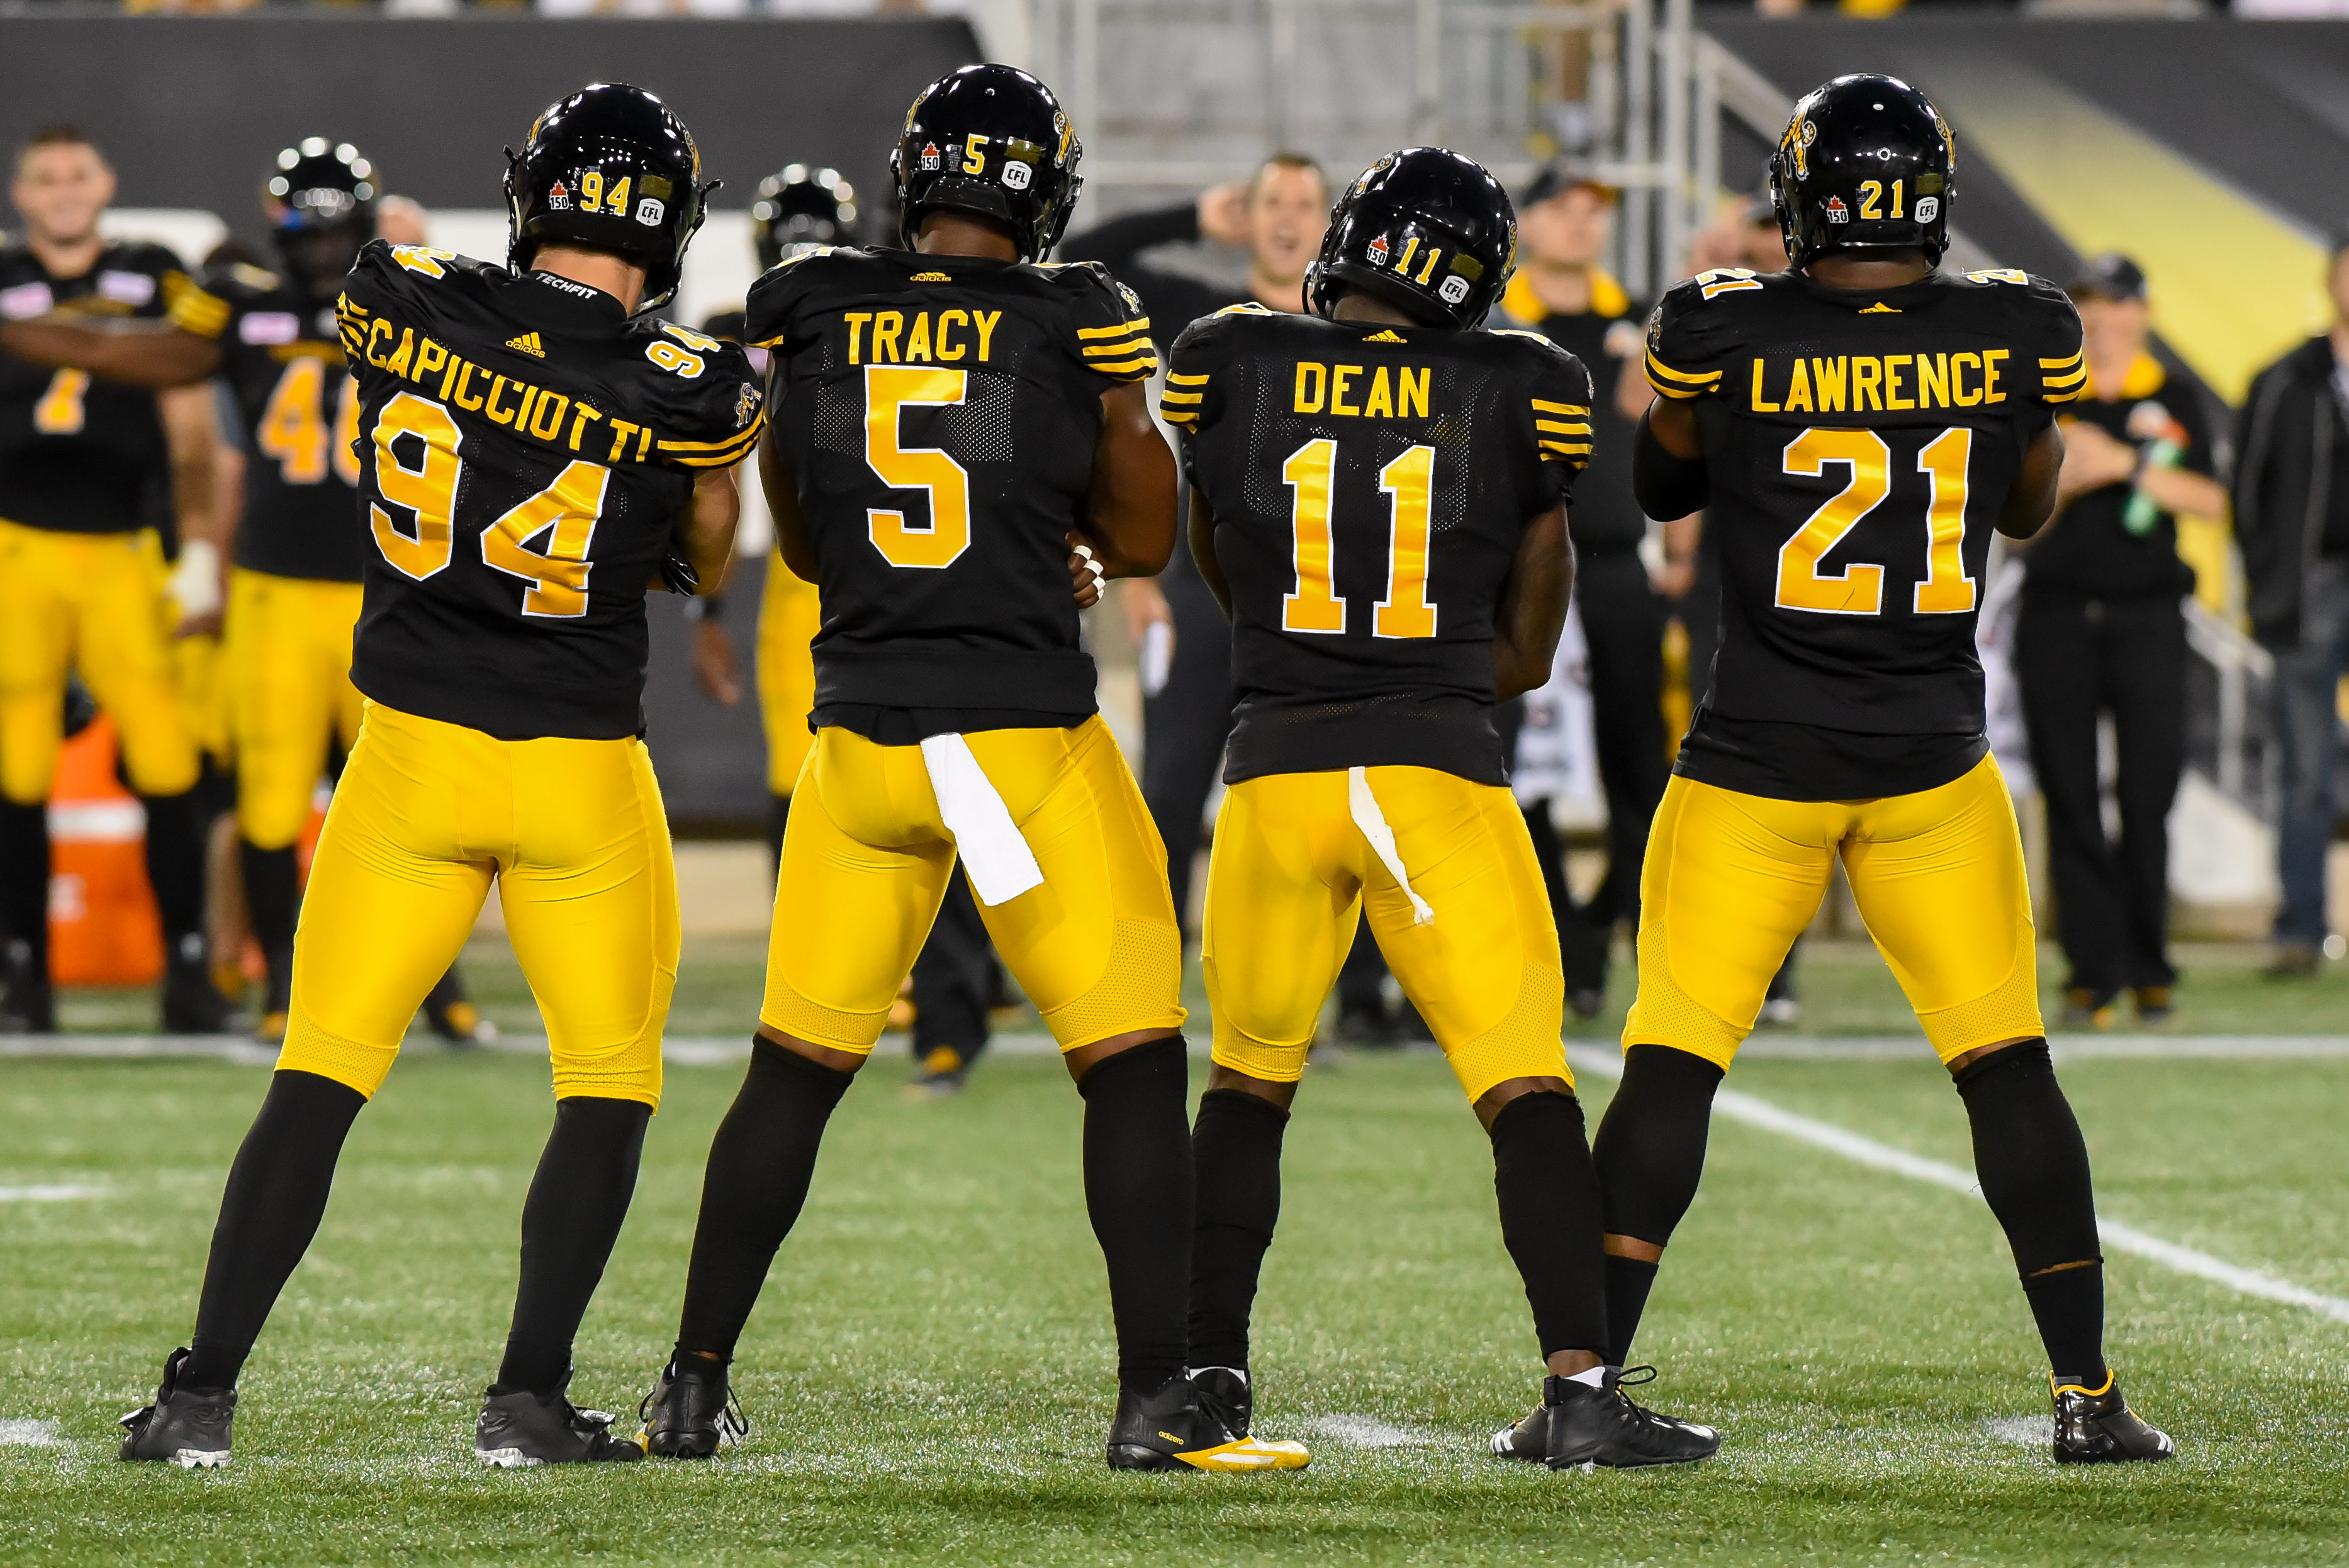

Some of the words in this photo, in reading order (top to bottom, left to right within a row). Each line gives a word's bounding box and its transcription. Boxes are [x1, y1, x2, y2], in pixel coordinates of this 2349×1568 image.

[922, 157, 939, 170] 150
[963, 133, 989, 175] 5
[580, 172, 631, 216] 94
[1007, 169, 1026, 184] CFL
[549, 196, 568, 209] 150
[641, 206, 659, 220] CFL
[1827, 211, 1848, 222] 150
[1861, 179, 1904, 219] 21
[1919, 204, 1934, 216] CFL
[1367, 247, 1386, 264] 150
[1395, 237, 1442, 286] 11
[535, 272, 598, 299] TECHFIT
[1444, 282, 1464, 298] CFL
[645, 325, 722, 379] 94
[844, 310, 1002, 365] TRACY
[366, 318, 652, 462] CAPICCIOTTI
[1294, 362, 1431, 418] DEAN
[1752, 349, 2010, 413] LAWRENCE
[864, 364, 971, 569] 5
[371, 390, 611, 618] 94
[1774, 427, 1975, 615] 21
[1282, 438, 1437, 639] 11
